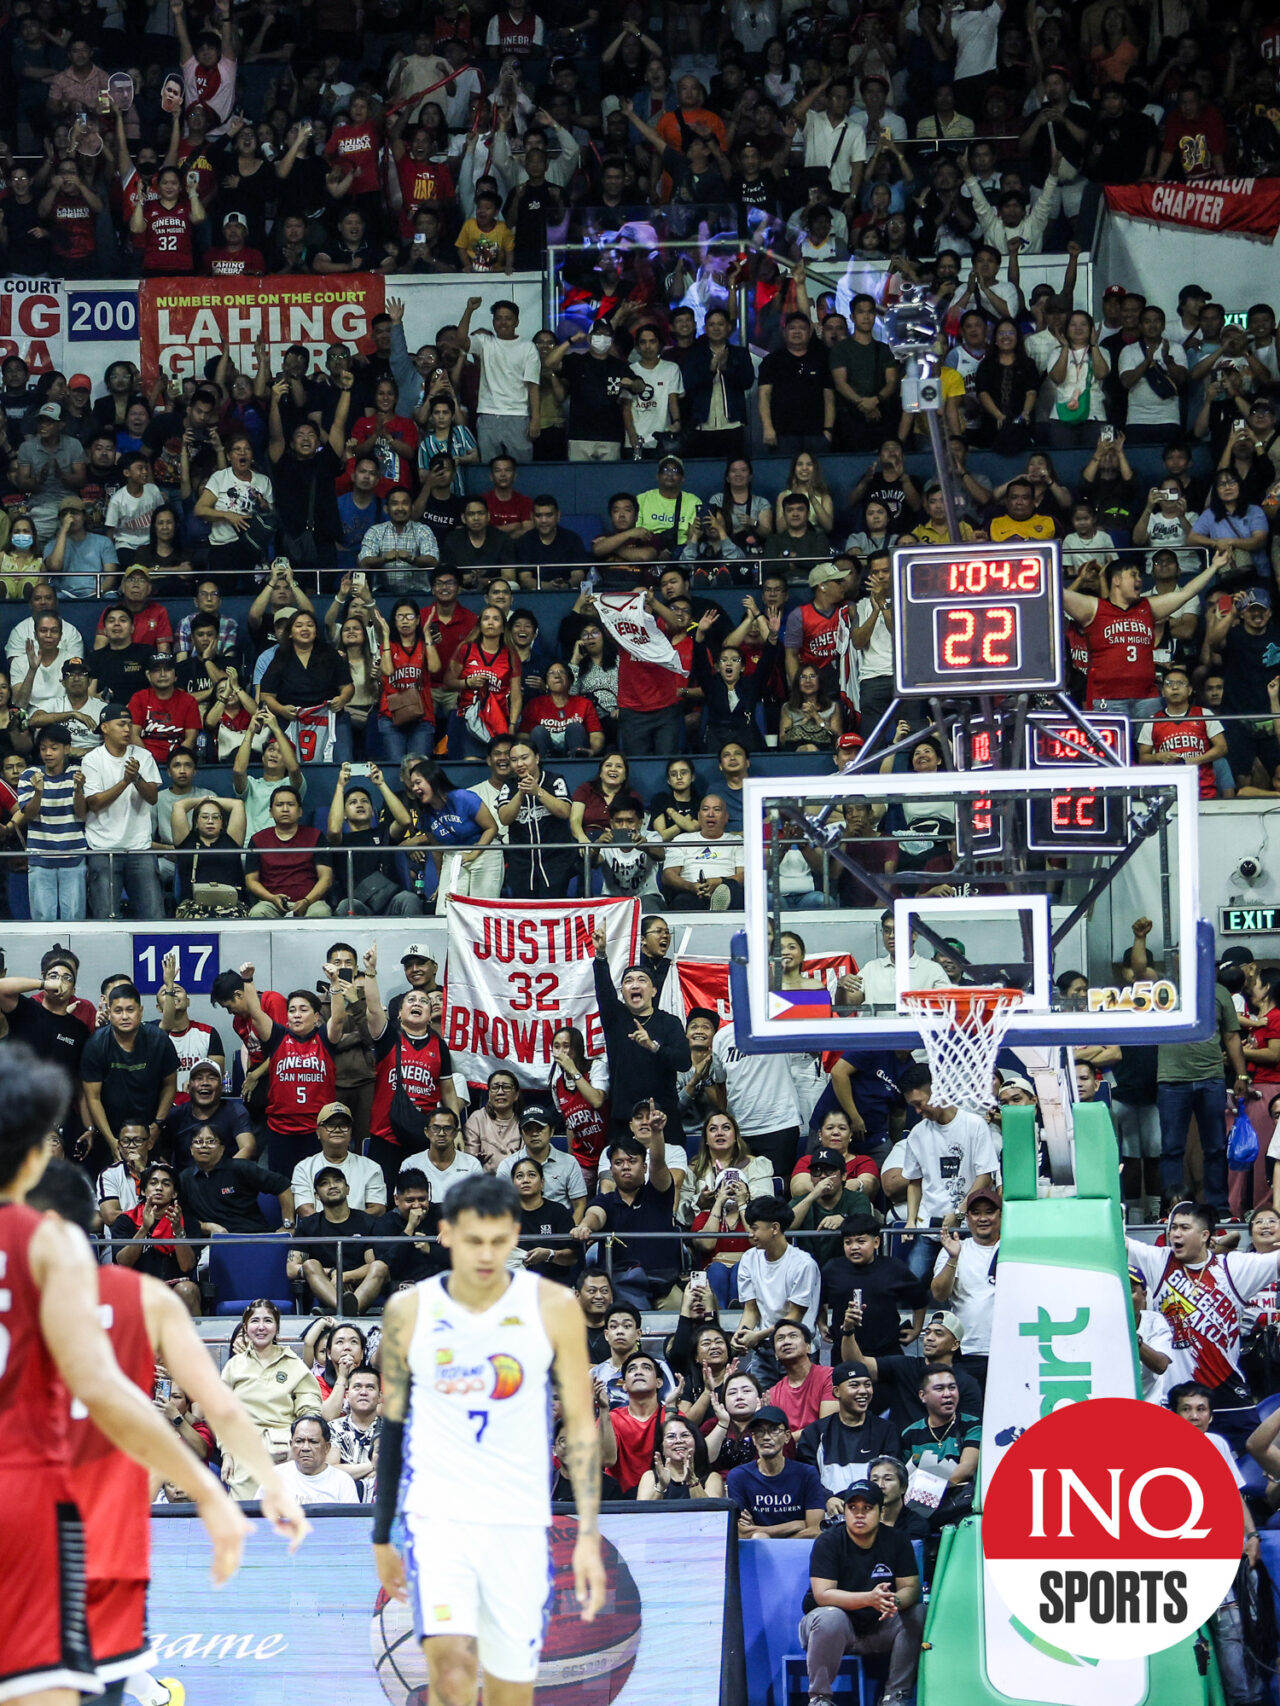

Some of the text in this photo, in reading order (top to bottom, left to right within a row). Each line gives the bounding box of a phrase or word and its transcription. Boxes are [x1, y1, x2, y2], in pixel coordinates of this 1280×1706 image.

[1151, 187, 1224, 224] CHAPTER
[158, 236, 178, 250] 32
[4, 280, 61, 294] COURT
[156, 291, 366, 307] NUMBER ONE ON THE COURT
[71, 301, 135, 332] 200
[157, 304, 367, 345] LAHING
[948, 558, 1040, 593] 1:04.2
[943, 608, 1013, 665] 22
[1104, 620, 1152, 641] GINEBRA
[1108, 635, 1151, 646] SAN MIGUEL
[1127, 646, 1137, 662] 3
[299, 730, 317, 762] 9
[1229, 911, 1275, 931] EXIT
[473, 914, 597, 965] JUSTIN
[508, 972, 560, 1011] 32
[276, 1055, 327, 1077] GINEBRA
[279, 1071, 324, 1083] SAN MIGUEL
[296, 1086, 306, 1103] 5
[467, 1410, 488, 1443] 7
[755, 1494, 792, 1506] POLO
[773, 1504, 802, 1514] LAUREN
